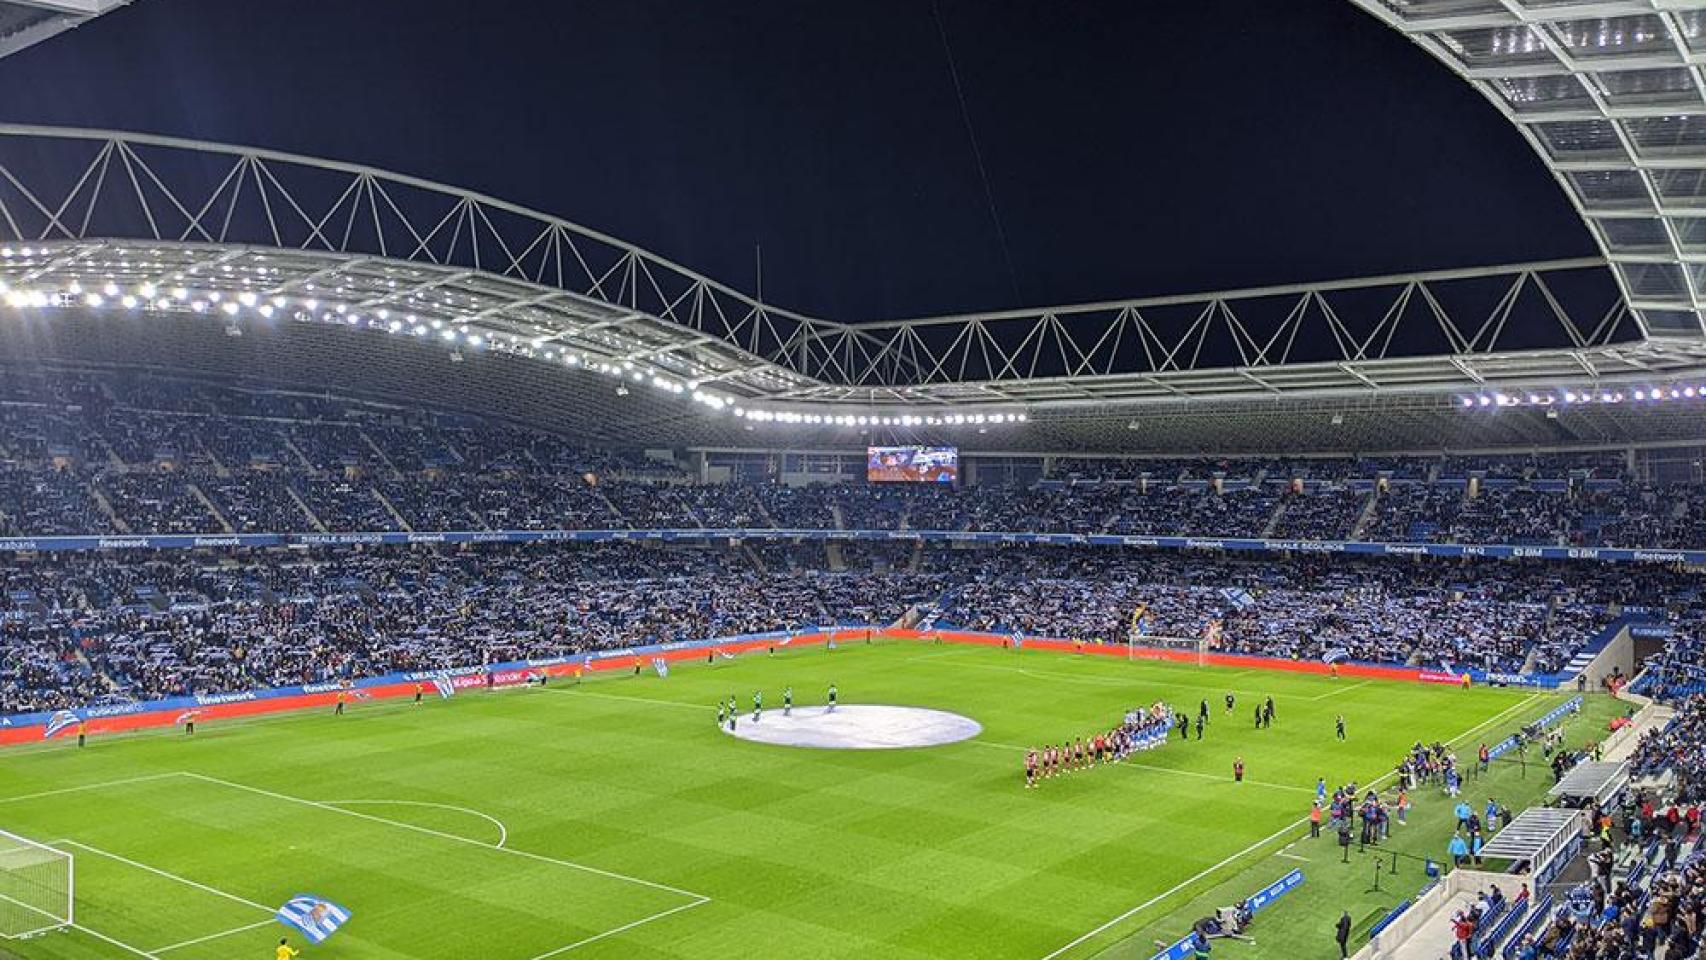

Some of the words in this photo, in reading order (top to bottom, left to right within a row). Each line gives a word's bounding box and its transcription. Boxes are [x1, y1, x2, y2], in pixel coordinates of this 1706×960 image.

[99, 539, 149, 548] finetwork
[194, 537, 240, 546] finetwork
[1385, 545, 1428, 553] finetwork
[1634, 551, 1685, 561] finetwork
[195, 691, 256, 705] finetwork
